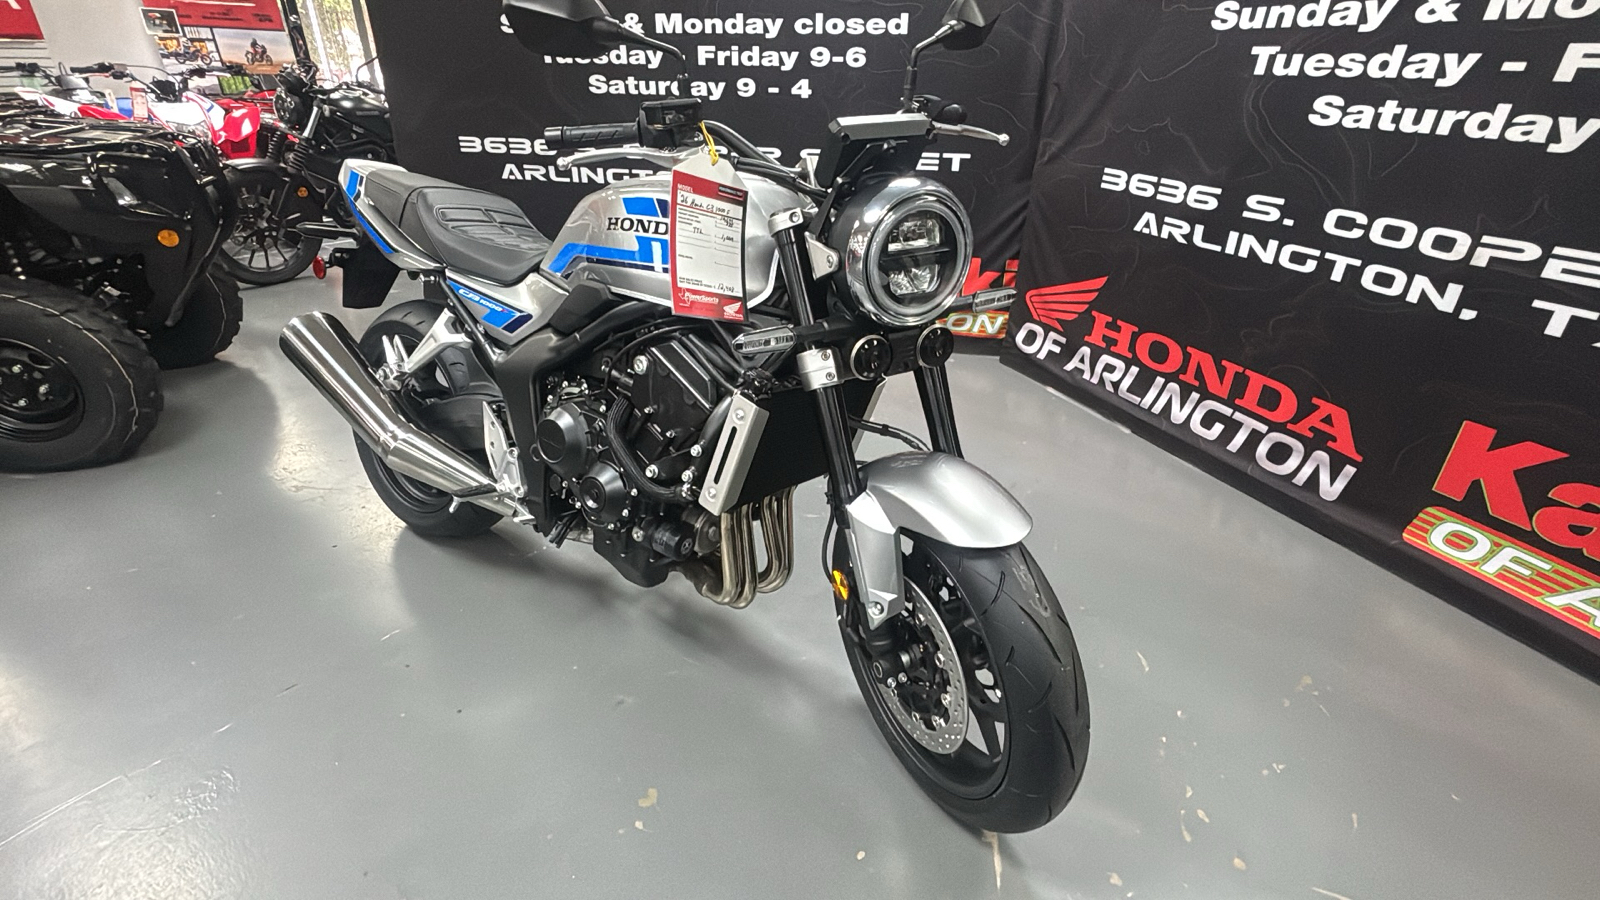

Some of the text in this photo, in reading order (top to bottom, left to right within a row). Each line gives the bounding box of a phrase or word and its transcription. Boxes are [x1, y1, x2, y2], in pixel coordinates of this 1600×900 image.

[654, 12, 784, 39] Monday
[793, 12, 909, 35] closed
[1211, 0, 1388, 32] Sunday
[697, 45, 800, 71] Friday
[809, 46, 867, 68] 9-6
[1251, 44, 1483, 87] Tuesday
[736, 77, 756, 97] 9
[791, 78, 812, 99] 4
[1308, 95, 1600, 154] Saturday
[501, 163, 673, 184] ARLINGT
[1100, 167, 1223, 211] 3636
[1242, 194, 1295, 227] S.
[606, 217, 669, 235] HOND
[1133, 211, 1478, 321] ARLINGTON,
[1084, 310, 1363, 462] HONDA
[1015, 321, 1357, 501] OF ARLINGTON
[1429, 521, 1553, 576] OF
